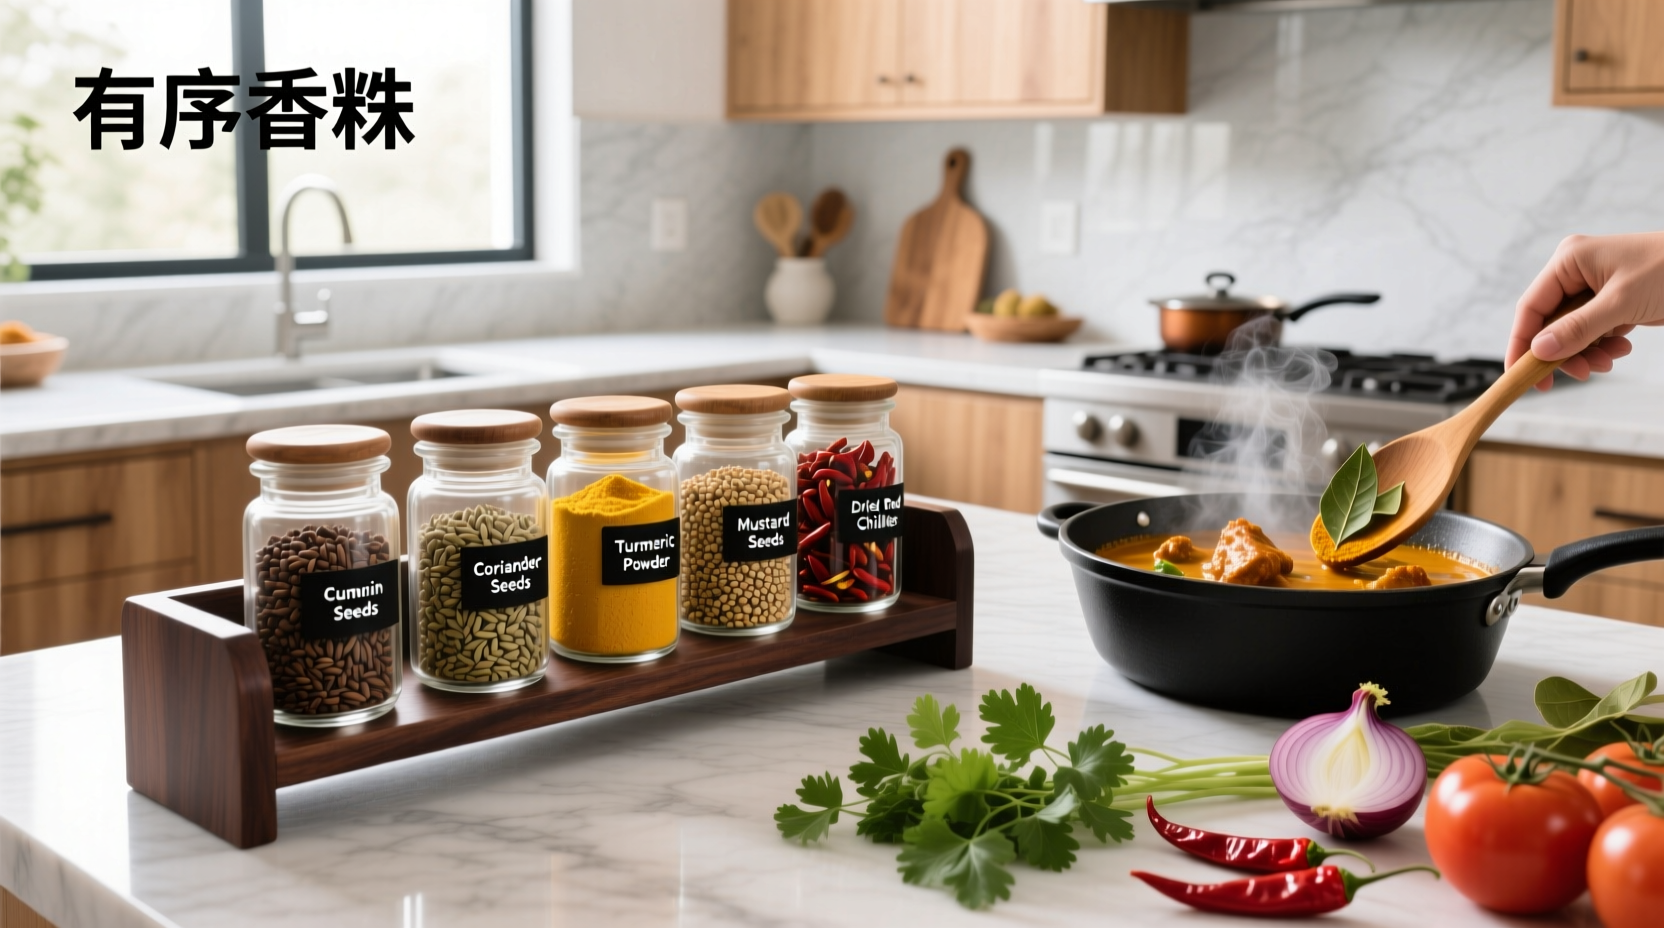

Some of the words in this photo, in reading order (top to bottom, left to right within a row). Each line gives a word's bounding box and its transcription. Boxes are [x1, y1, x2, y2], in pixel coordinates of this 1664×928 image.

[737, 511, 790, 532] Mustard
[614, 534, 675, 554] Turmeric
[748, 532, 785, 549] Seeds
[473, 556, 542, 577] Coriander
[623, 555, 671, 572] Powder
[490, 575, 531, 594] Seeds
[333, 600, 379, 622] Seeds
